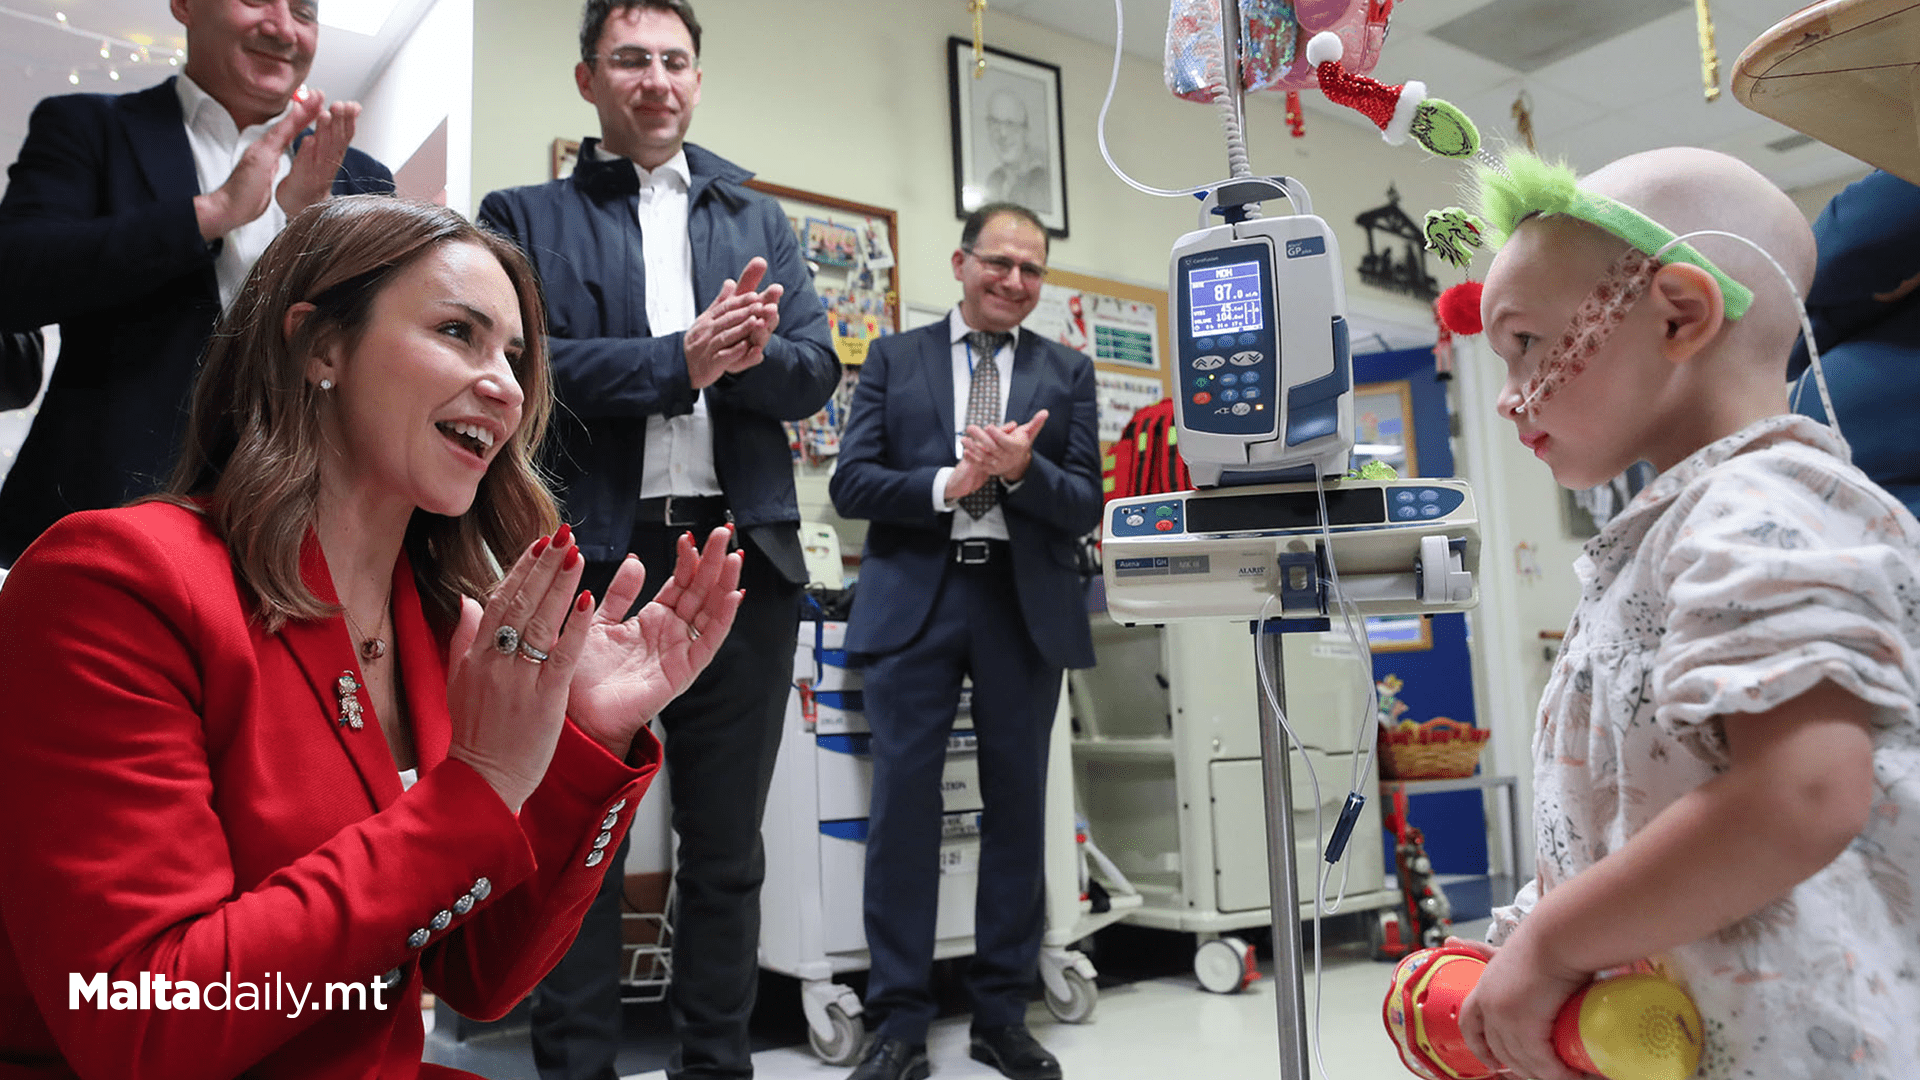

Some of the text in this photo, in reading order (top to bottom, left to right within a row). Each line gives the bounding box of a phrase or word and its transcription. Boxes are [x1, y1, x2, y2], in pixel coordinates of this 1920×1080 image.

[1288, 247, 1301, 256] GP
[1214, 283, 1243, 301] 87.0
[1156, 558, 1167, 566] GH
[1238, 567, 1264, 575] ALARIS
